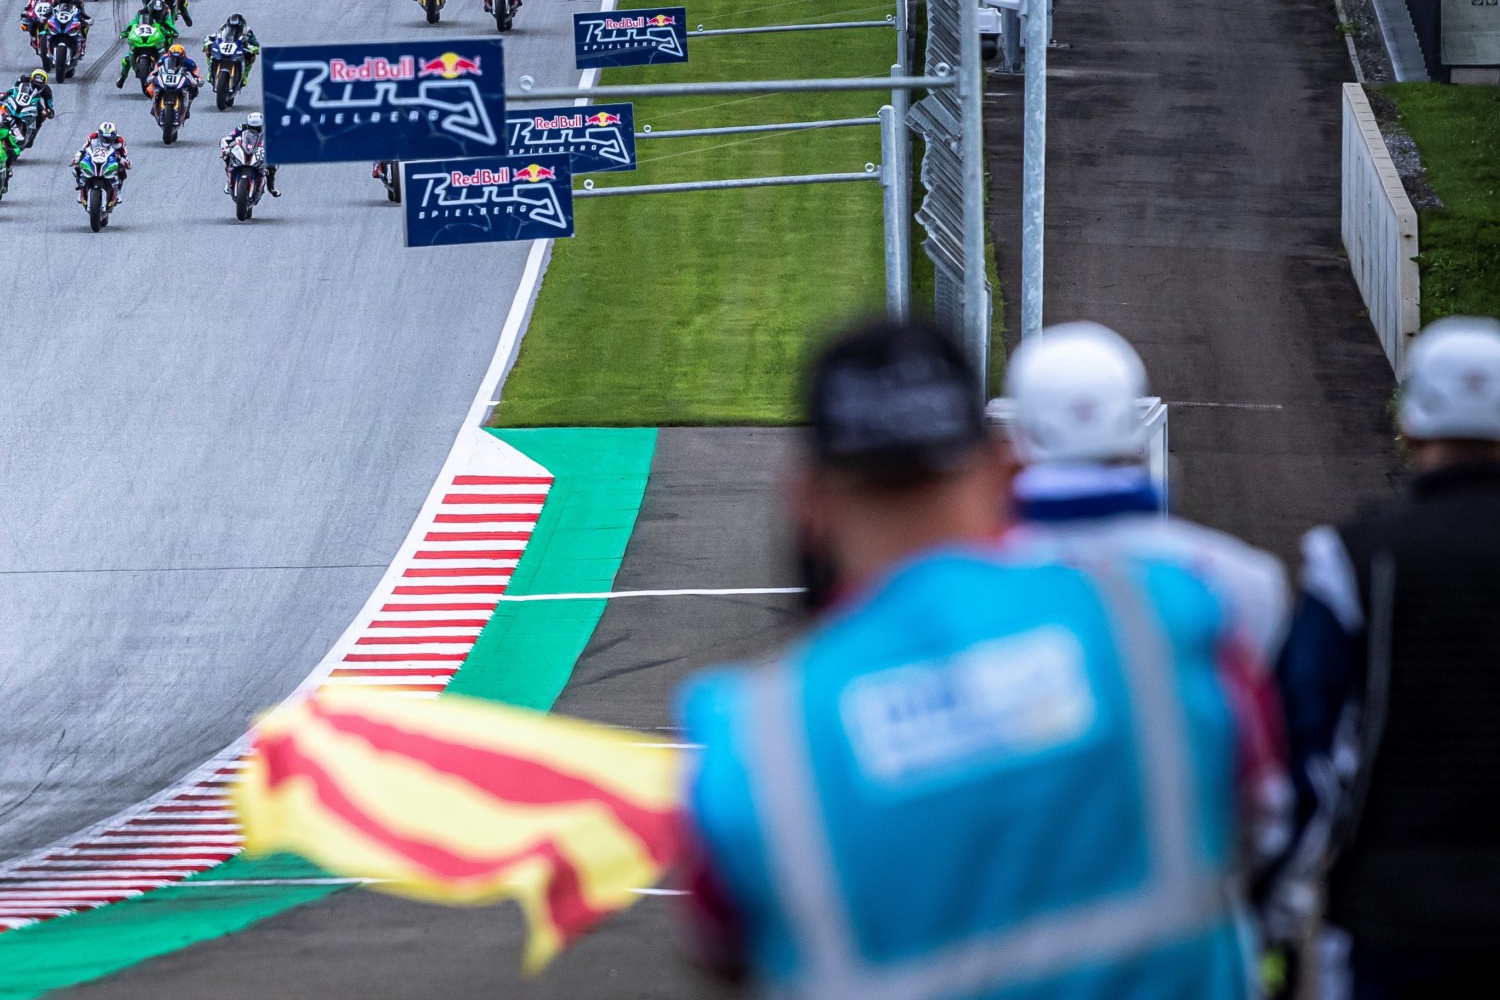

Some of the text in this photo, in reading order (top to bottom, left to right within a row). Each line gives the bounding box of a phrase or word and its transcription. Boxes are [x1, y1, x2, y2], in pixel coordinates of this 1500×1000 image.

[606, 16, 645, 30] Red Bull
[221, 43, 233, 53] 41
[583, 41, 657, 51] SPIELBERG
[330, 55, 415, 83] Red Bull
[165, 74, 177, 84] 91
[18, 93, 30, 103] 19
[281, 110, 440, 127] SPIELBERG
[535, 114, 582, 130] Red Bull
[93, 148, 107, 158] 28
[508, 144, 597, 155] SPIELBERG
[451, 167, 510, 187] Red Bull
[418, 205, 527, 219] SPIELBERG
